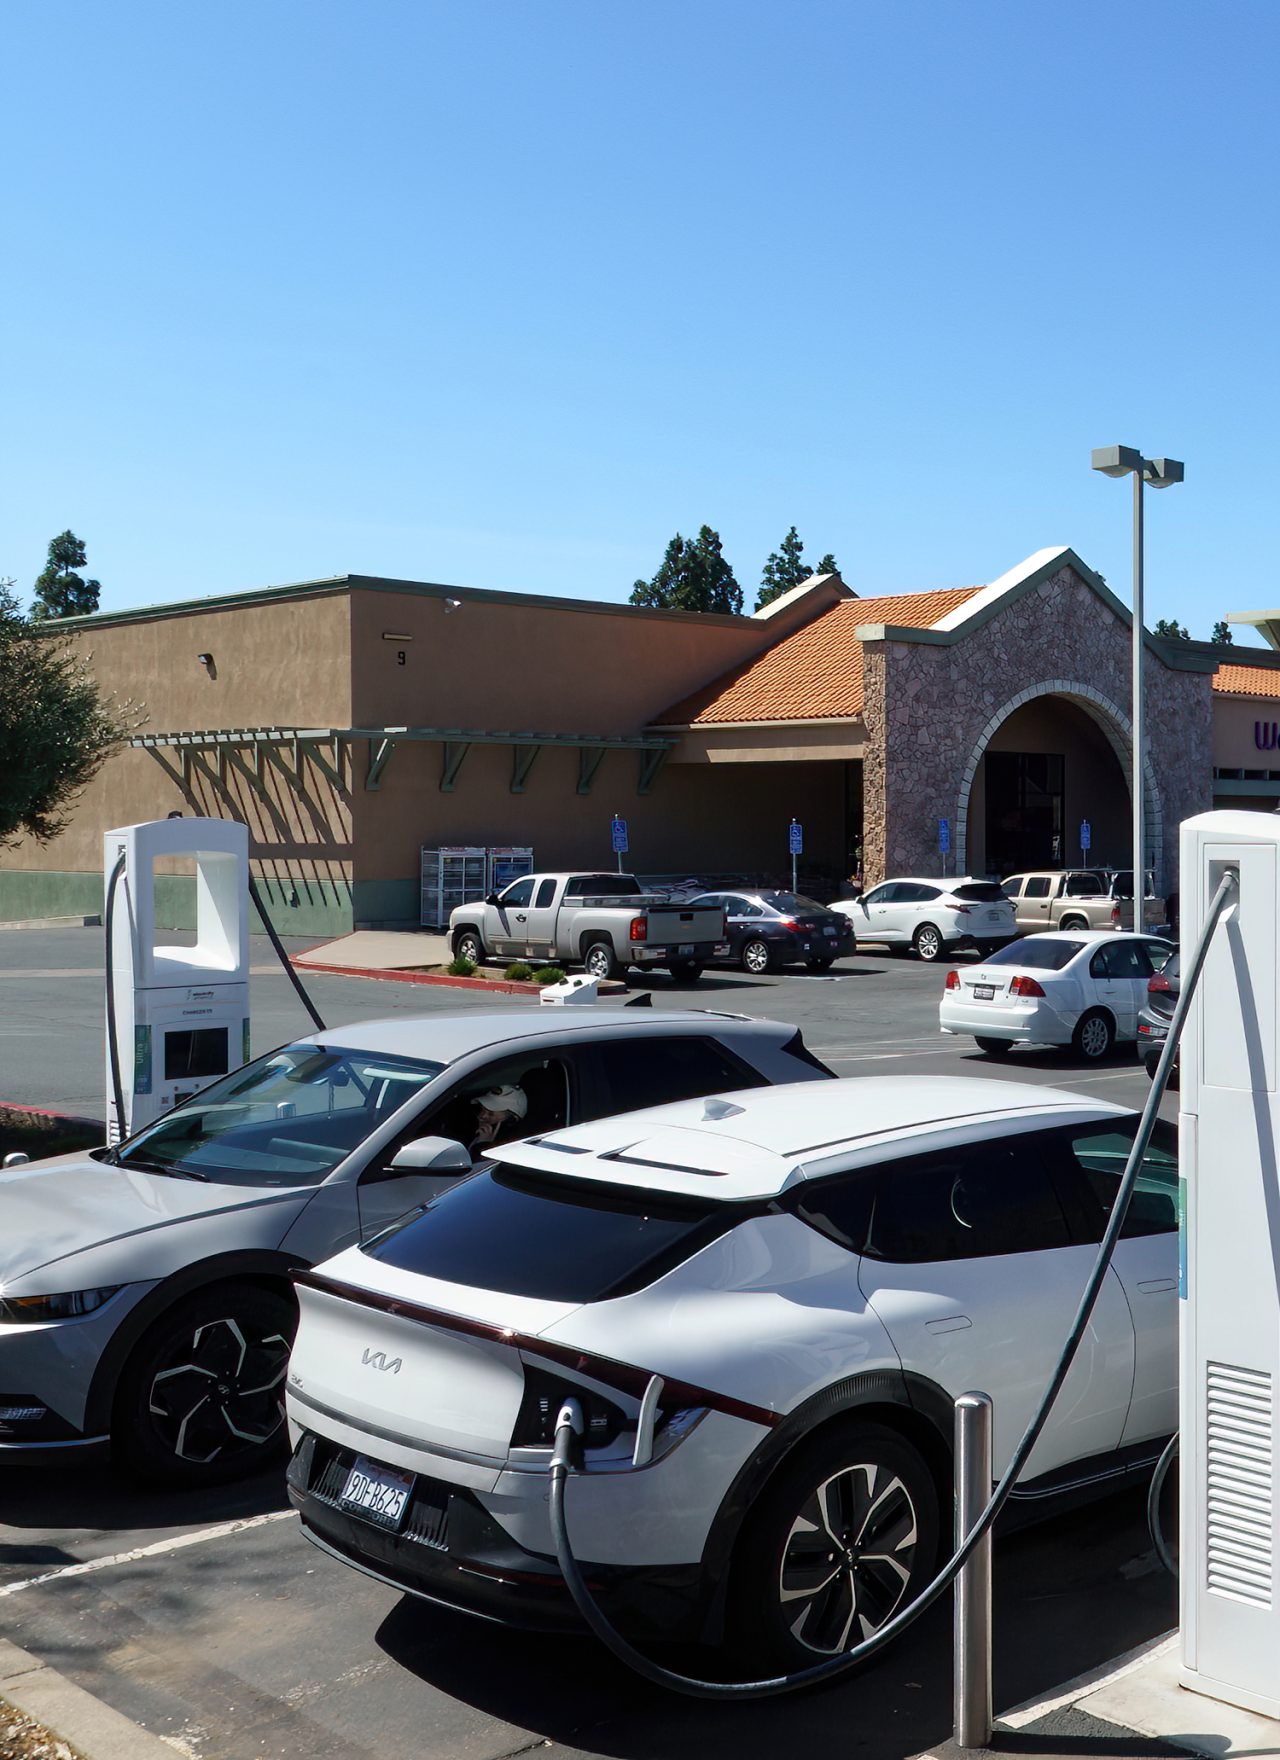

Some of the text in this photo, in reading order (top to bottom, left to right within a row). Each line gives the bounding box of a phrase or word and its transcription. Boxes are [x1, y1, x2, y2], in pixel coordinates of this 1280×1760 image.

[397, 651, 406, 665] 9
[361, 1348, 403, 1375] KIA
[346, 1474, 405, 1517] 9DFB625
